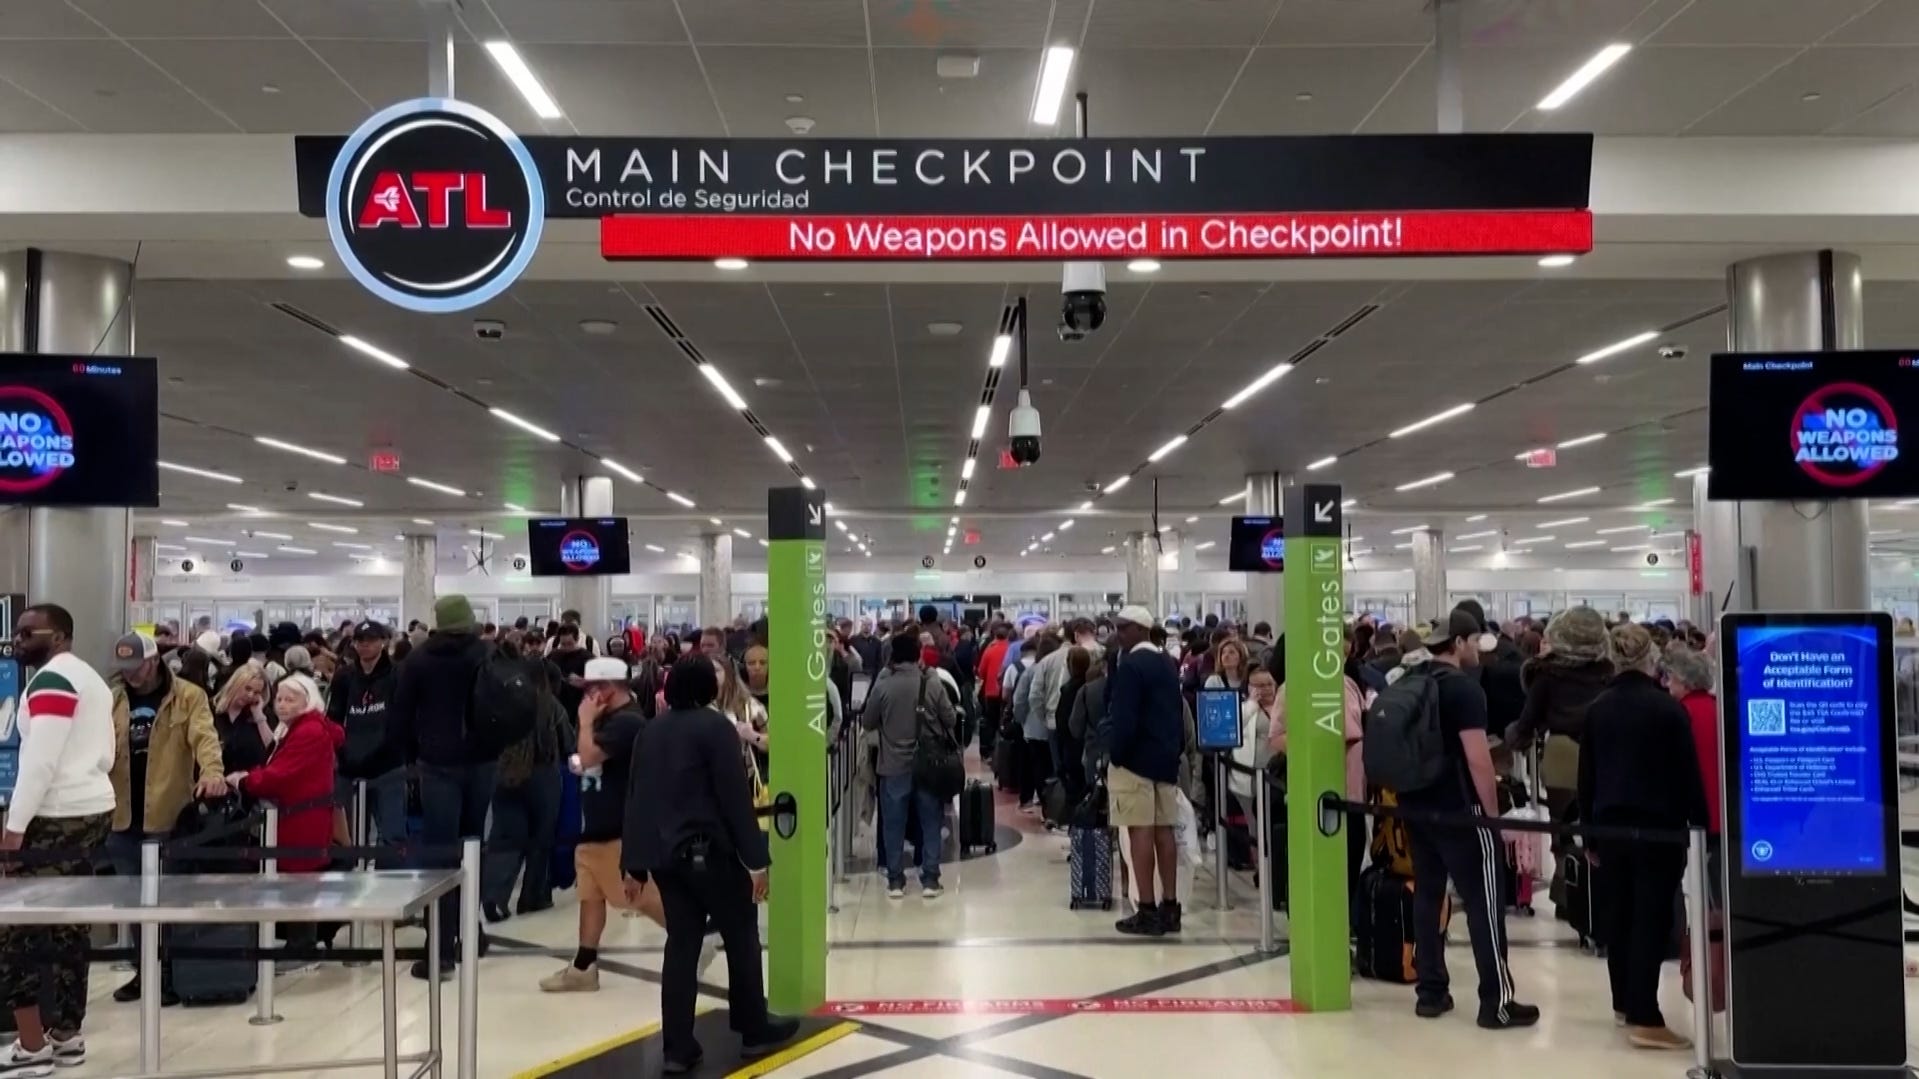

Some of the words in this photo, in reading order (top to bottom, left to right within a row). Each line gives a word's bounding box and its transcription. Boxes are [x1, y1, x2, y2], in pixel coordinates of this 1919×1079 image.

[566, 149, 730, 185] MAIN
[775, 146, 1208, 186] CHECKPOINT
[357, 171, 512, 229] ATL
[566, 188, 653, 208] Control
[659, 188, 687, 208] de
[694, 188, 810, 212] Seguridad
[789, 221, 836, 251] No
[846, 222, 1007, 256] Weapons
[1016, 220, 1148, 250] Allowed
[1161, 220, 1188, 250] in
[1200, 217, 1402, 254] Checkpoint!
[0, 412, 42, 433] NO
[1825, 407, 1868, 429] NO
[1796, 429, 1898, 445] WEAPONS
[1795, 445, 1899, 463] ALLOWED
[806, 583, 826, 681] Gates
[1313, 579, 1342, 679] Gates
[1770, 651, 1799, 662] Don't
[1801, 651, 1830, 662] Have
[1831, 652, 1846, 662] an
[1763, 664, 1822, 676] Acceptable
[1823, 665, 1853, 675] Form
[1762, 678, 1775, 688] of
[1777, 678, 1854, 688] Identification?
[806, 694, 826, 736] All
[1311, 692, 1342, 736] All
[921, 999, 1045, 1010] FIRARMS
